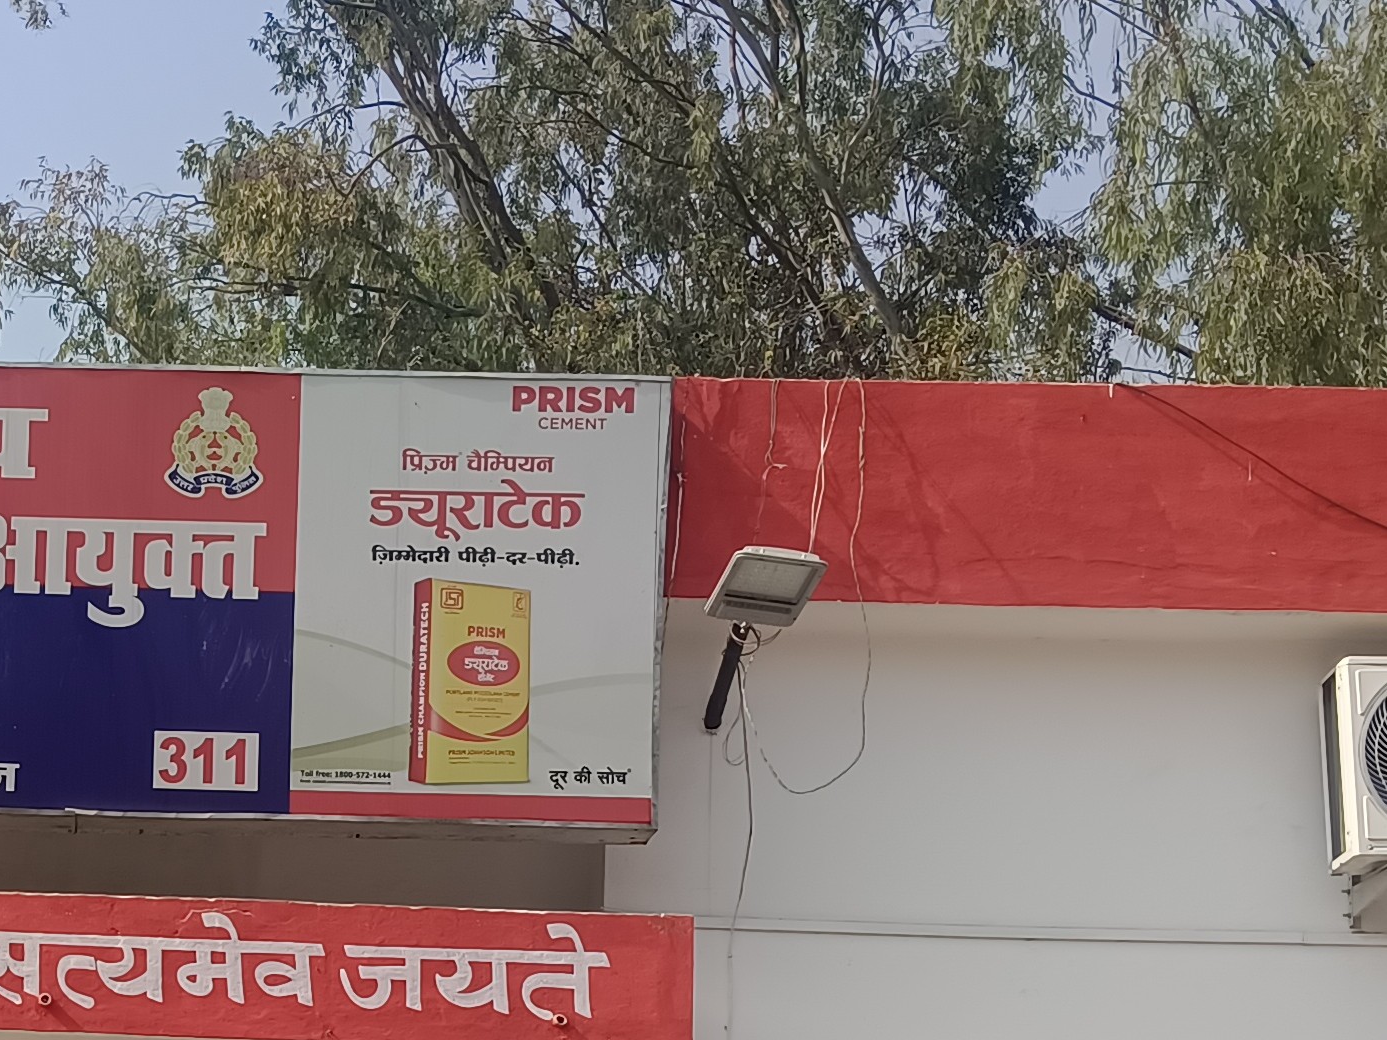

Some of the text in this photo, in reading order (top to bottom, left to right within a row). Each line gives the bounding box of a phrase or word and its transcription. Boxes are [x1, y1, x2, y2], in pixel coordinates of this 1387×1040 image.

[512, 385, 636, 413] PRISM
[538, 417, 608, 430] CEMENT
[467, 449, 555, 473] चैम्पियन
[369, 478, 586, 542] ड्यूराटेक
[418, 602, 430, 672] DURATECH
[467, 625, 506, 639] PRISM
[158, 736, 247, 785] 311
[549, 765, 628, 790] दूर की सोच
[340, 923, 611, 1021] जयते
